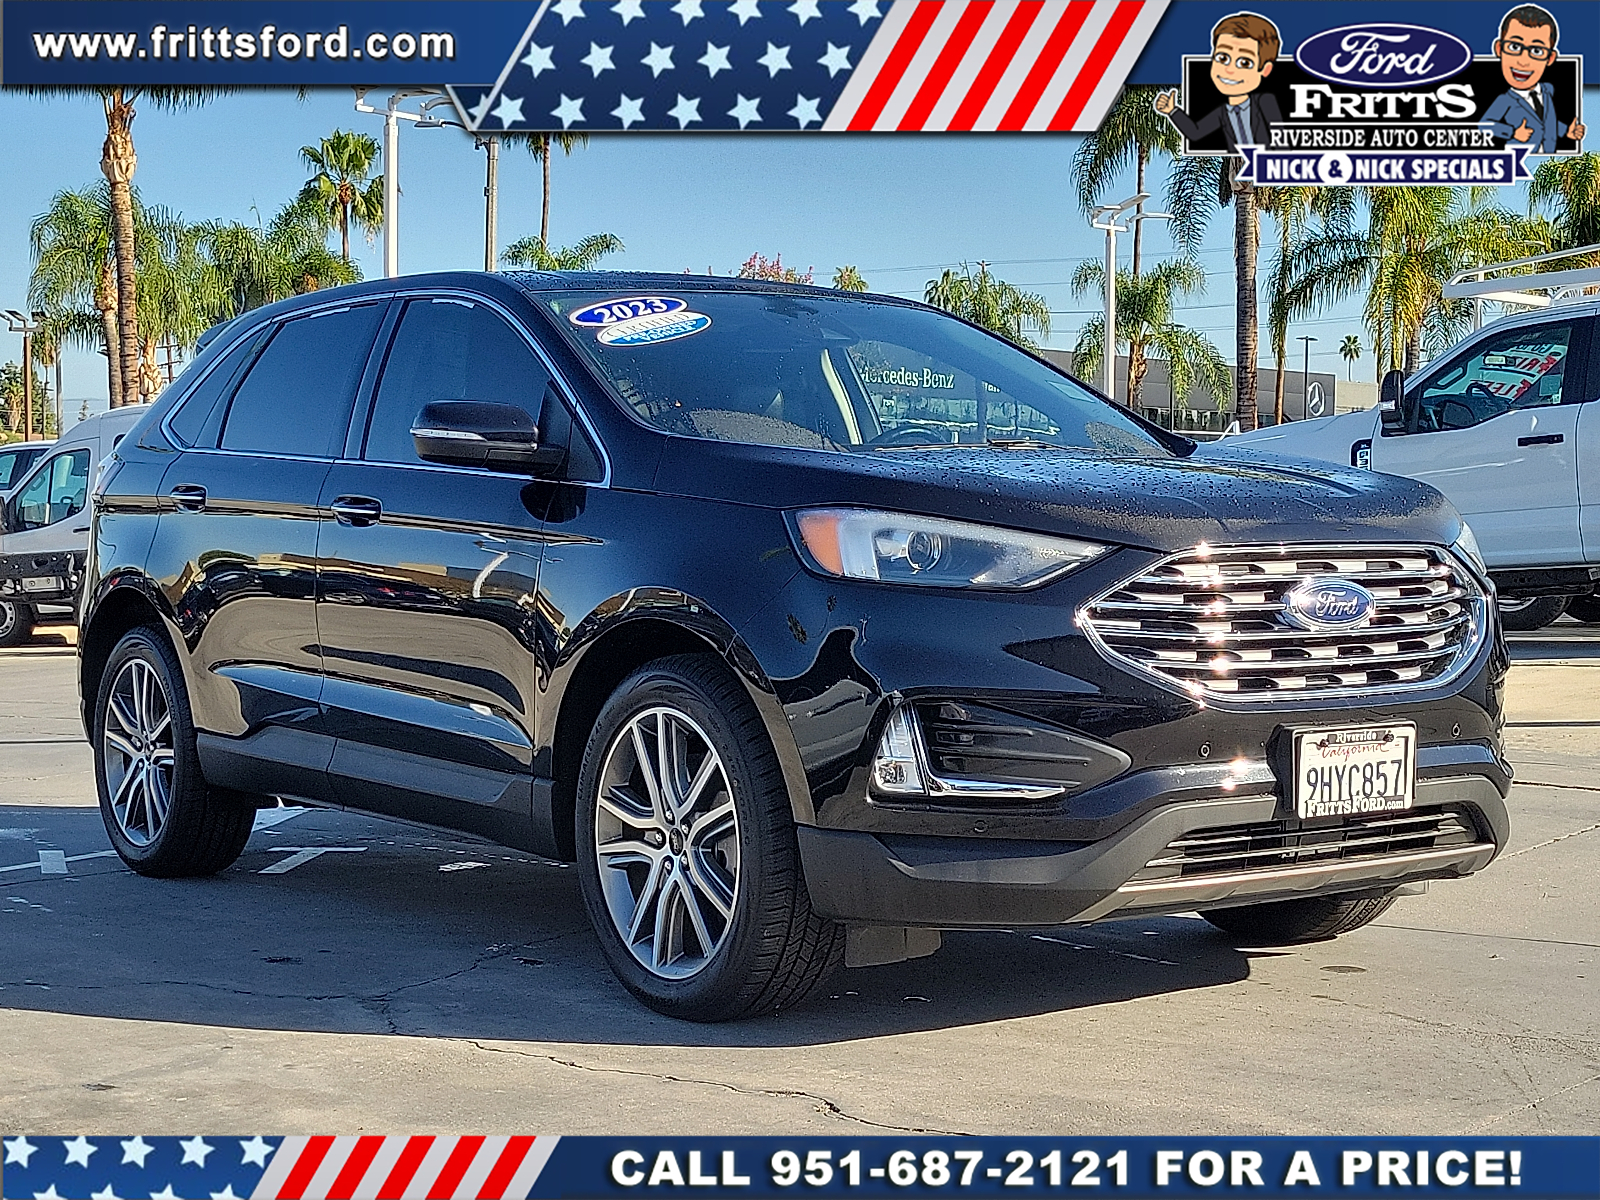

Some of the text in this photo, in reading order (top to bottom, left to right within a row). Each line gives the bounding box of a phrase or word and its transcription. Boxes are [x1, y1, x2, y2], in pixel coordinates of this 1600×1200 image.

[594, 299, 668, 323] 2023
[1315, 590, 1359, 617] Ford
[1336, 731, 1377, 743] Riverside
[1321, 743, 1389, 762] California
[1306, 759, 1403, 801] 9HYC857
